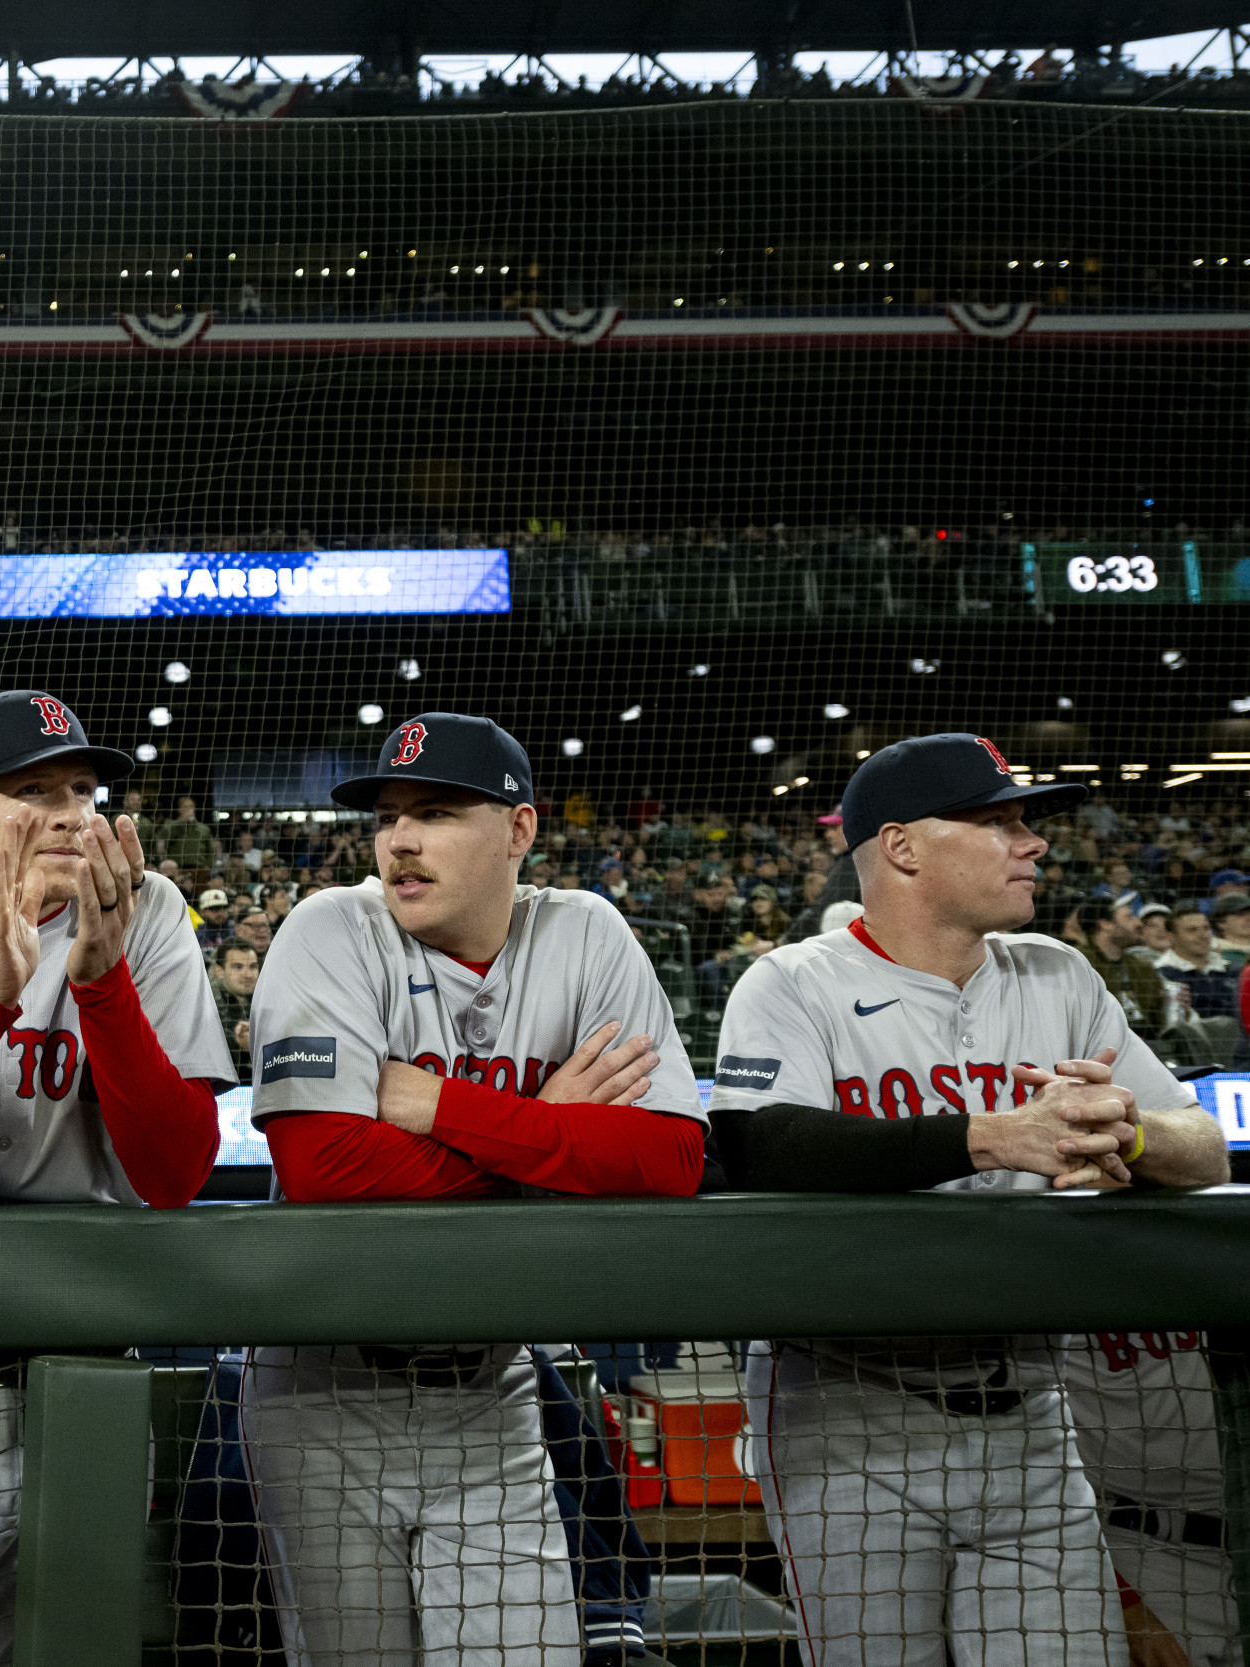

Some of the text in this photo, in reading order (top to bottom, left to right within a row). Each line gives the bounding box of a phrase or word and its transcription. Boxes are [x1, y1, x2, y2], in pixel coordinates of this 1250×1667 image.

[136, 567, 392, 598] STARBUCKS
[1067, 555, 1158, 592] 6:33
[31, 697, 71, 735] B
[391, 722, 428, 766] B
[272, 1051, 333, 1067] MassMutual
[717, 1066, 775, 1080] assMutual
[834, 1060, 1064, 1119] BOST
